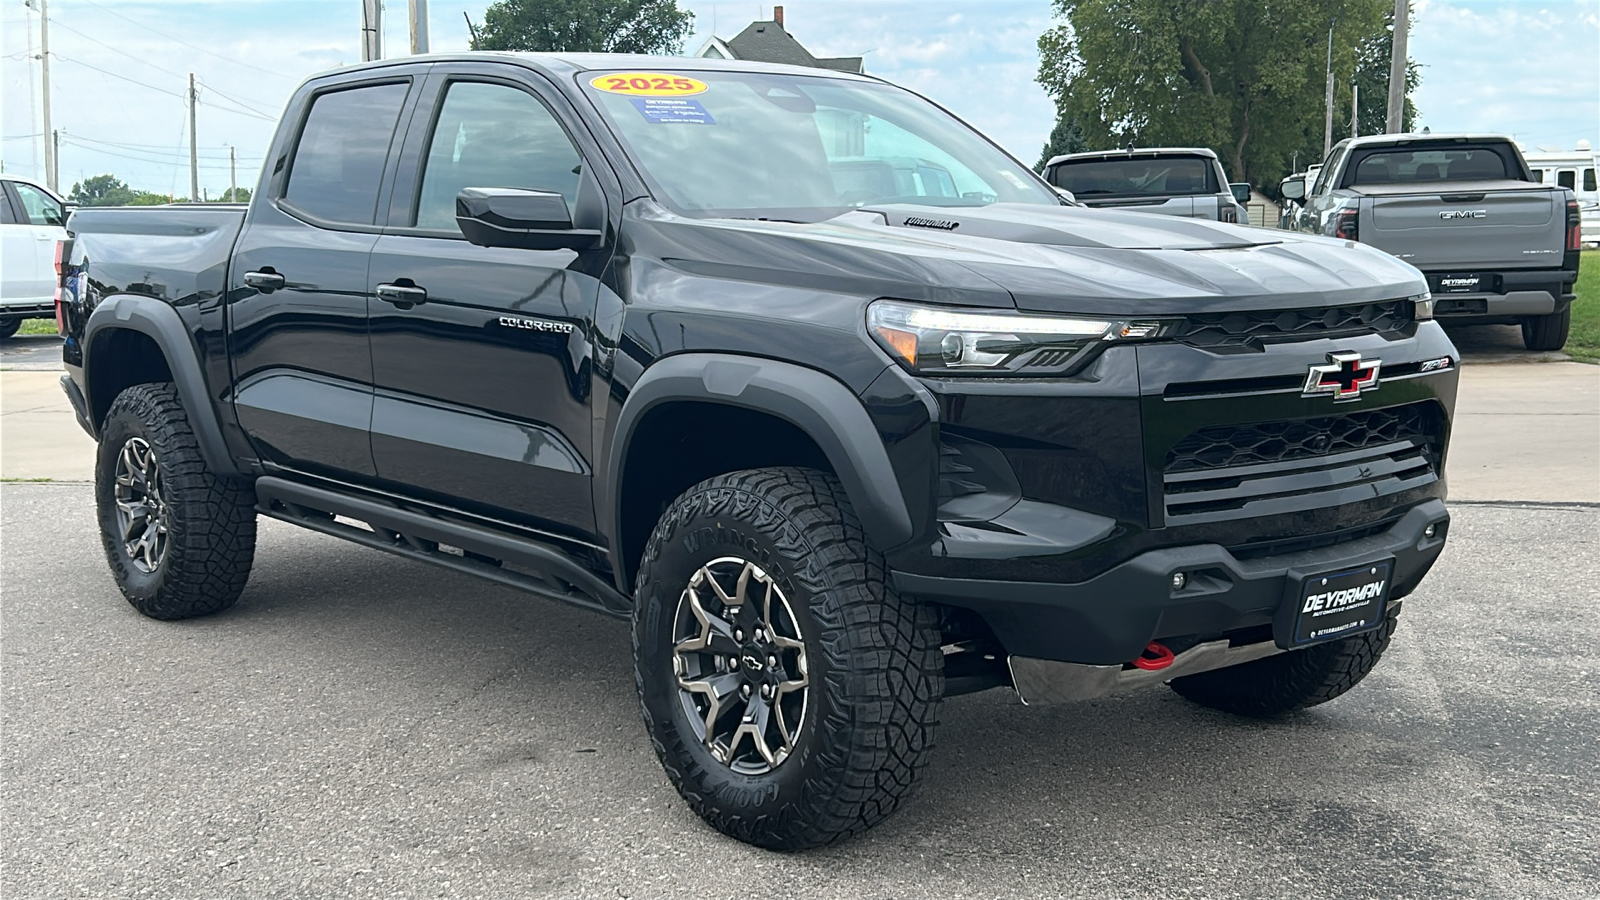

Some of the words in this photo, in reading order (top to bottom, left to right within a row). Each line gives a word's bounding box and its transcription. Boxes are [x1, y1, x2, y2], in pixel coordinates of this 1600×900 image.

[606, 77, 695, 91] 2025
[1438, 209, 1487, 220] GMC
[903, 216, 960, 231] TURBOMAX
[499, 316, 573, 334] COLORADO
[1420, 357, 1450, 372] ZR2
[1302, 580, 1385, 614] DEYARMAN
